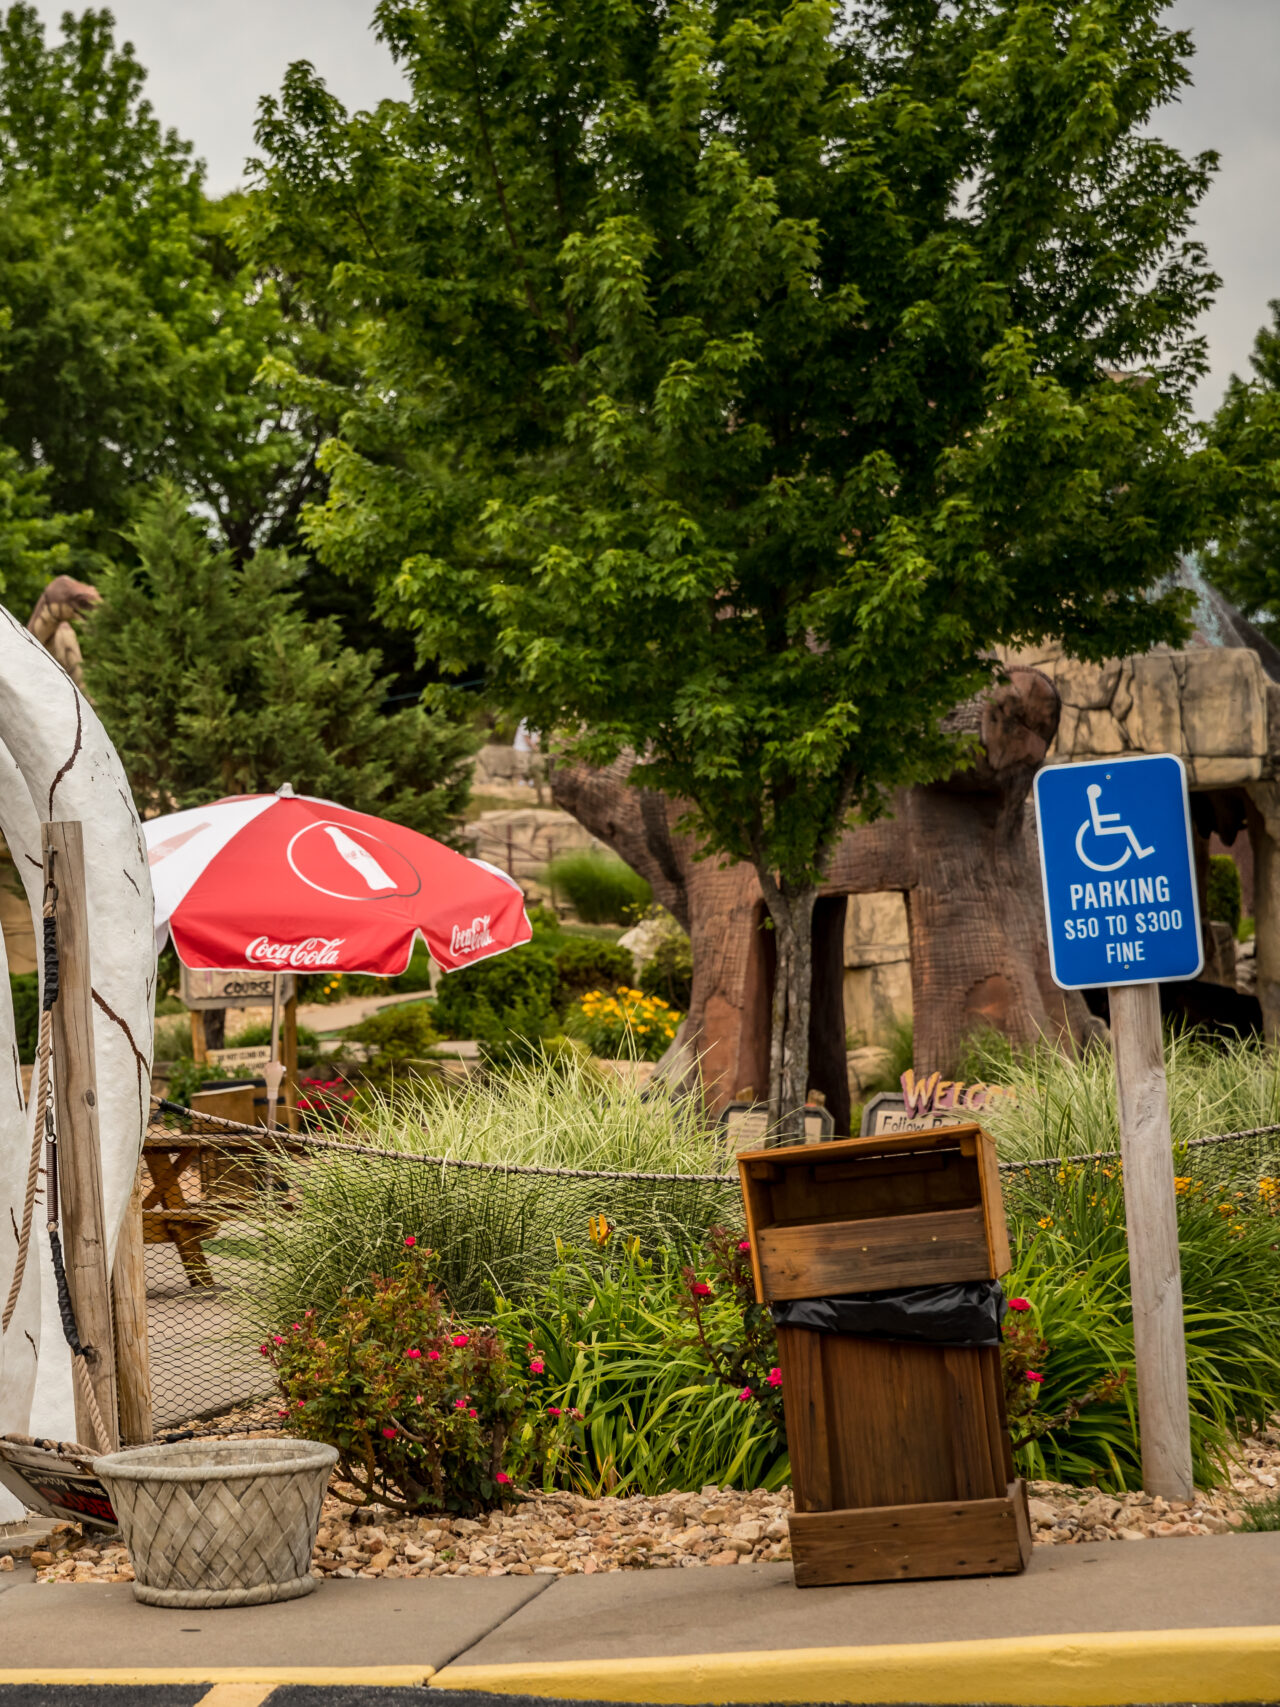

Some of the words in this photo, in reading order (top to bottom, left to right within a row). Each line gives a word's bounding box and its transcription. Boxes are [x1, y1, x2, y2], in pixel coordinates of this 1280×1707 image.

[1070, 875, 1170, 911] PARKING
[1064, 917, 1099, 940] $50
[1105, 915, 1128, 936] TO
[1135, 909, 1183, 934] $300
[245, 935, 346, 967] Coca-Cola
[1106, 940, 1146, 963] FINE
[223, 981, 272, 995] COURSE
